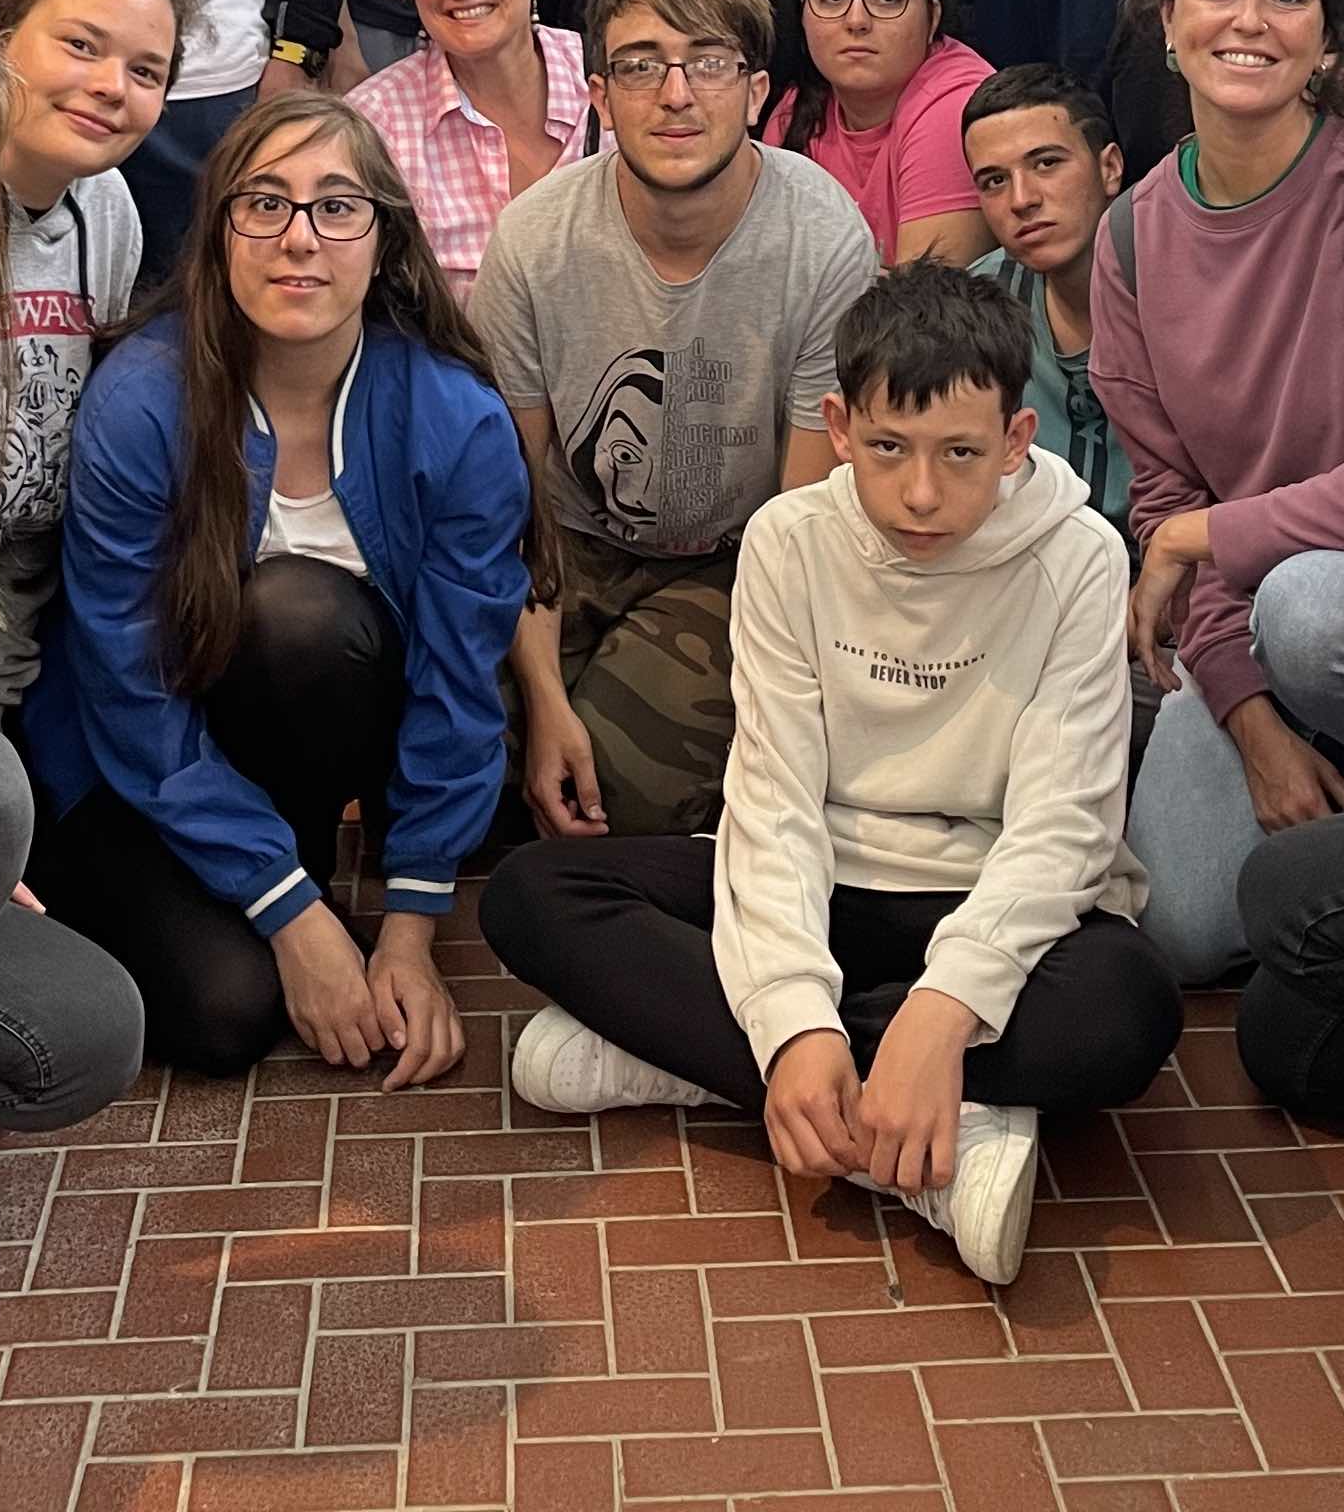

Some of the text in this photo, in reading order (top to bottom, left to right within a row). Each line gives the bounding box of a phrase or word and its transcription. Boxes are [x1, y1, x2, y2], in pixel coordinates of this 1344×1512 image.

[834, 640, 865, 657] DARE
[873, 651, 888, 662] TO
[913, 652, 986, 672] DIFFERENT
[869, 664, 947, 690] NEVER STOP
